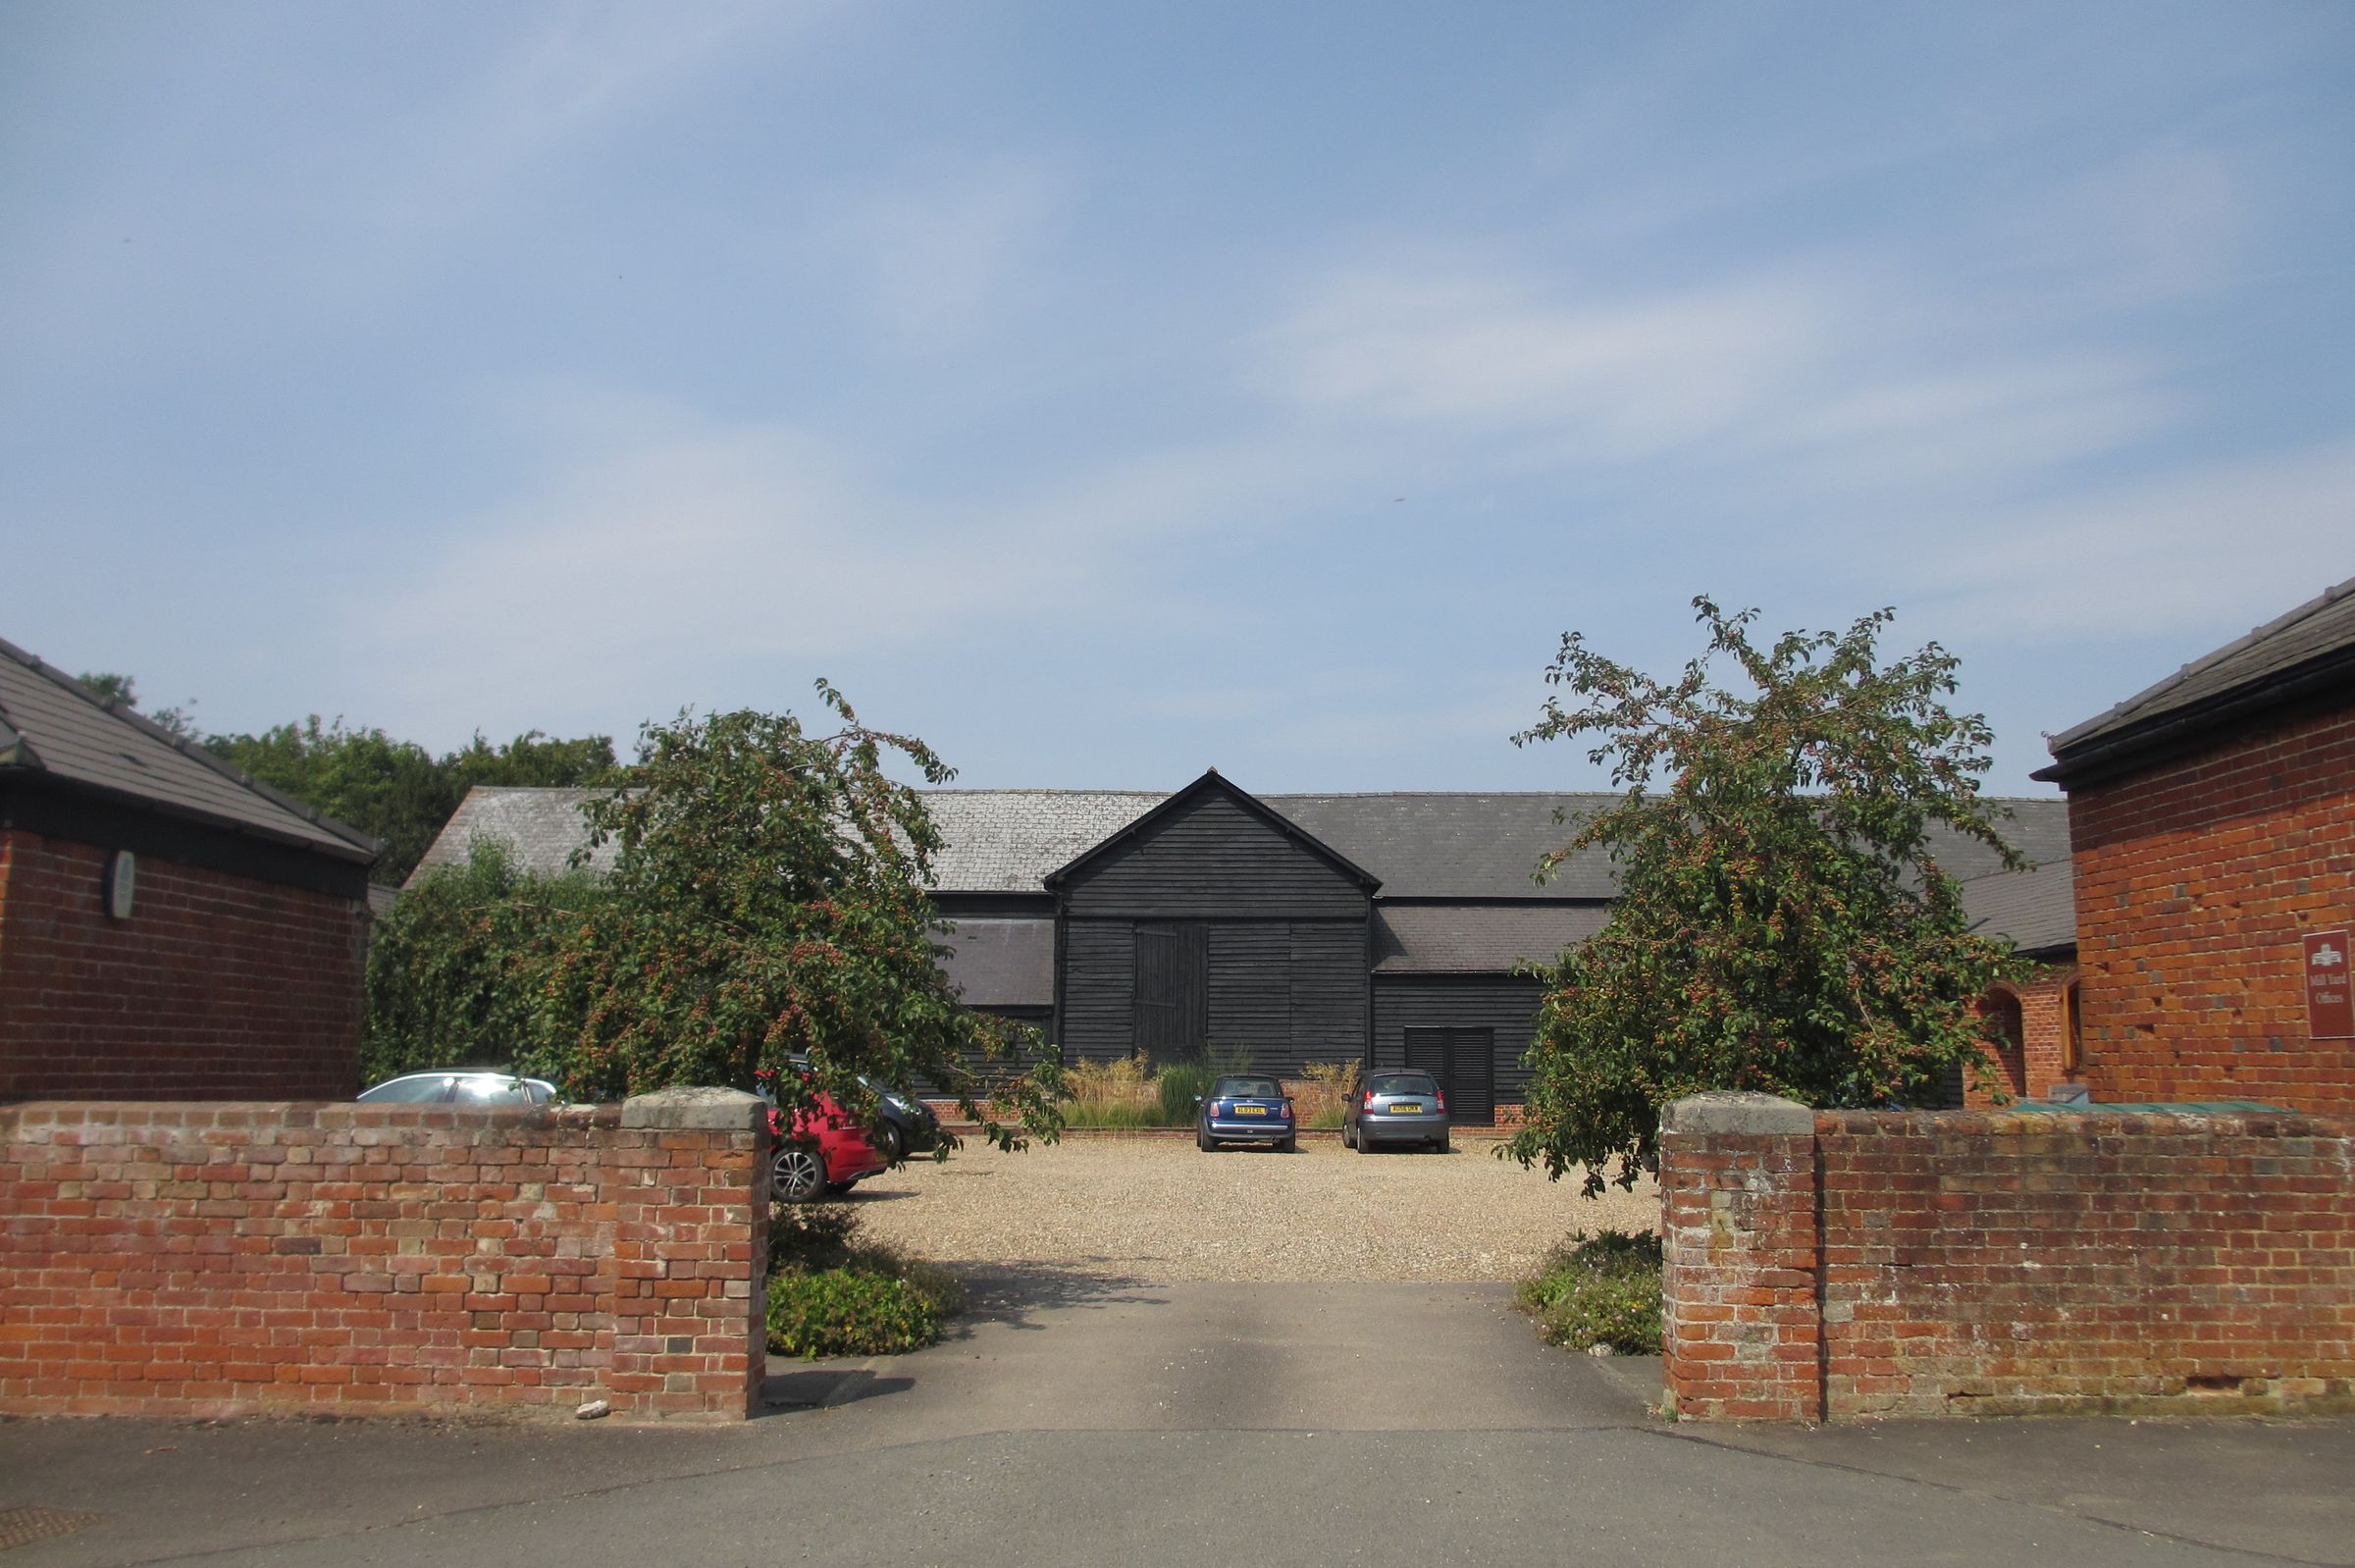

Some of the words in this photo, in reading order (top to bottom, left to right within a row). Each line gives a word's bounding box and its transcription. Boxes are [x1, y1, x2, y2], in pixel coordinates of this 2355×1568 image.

[2310, 973, 2327, 986] Mill
[2328, 971, 2346, 985] Yard
[2315, 991, 2344, 1005] Offices
